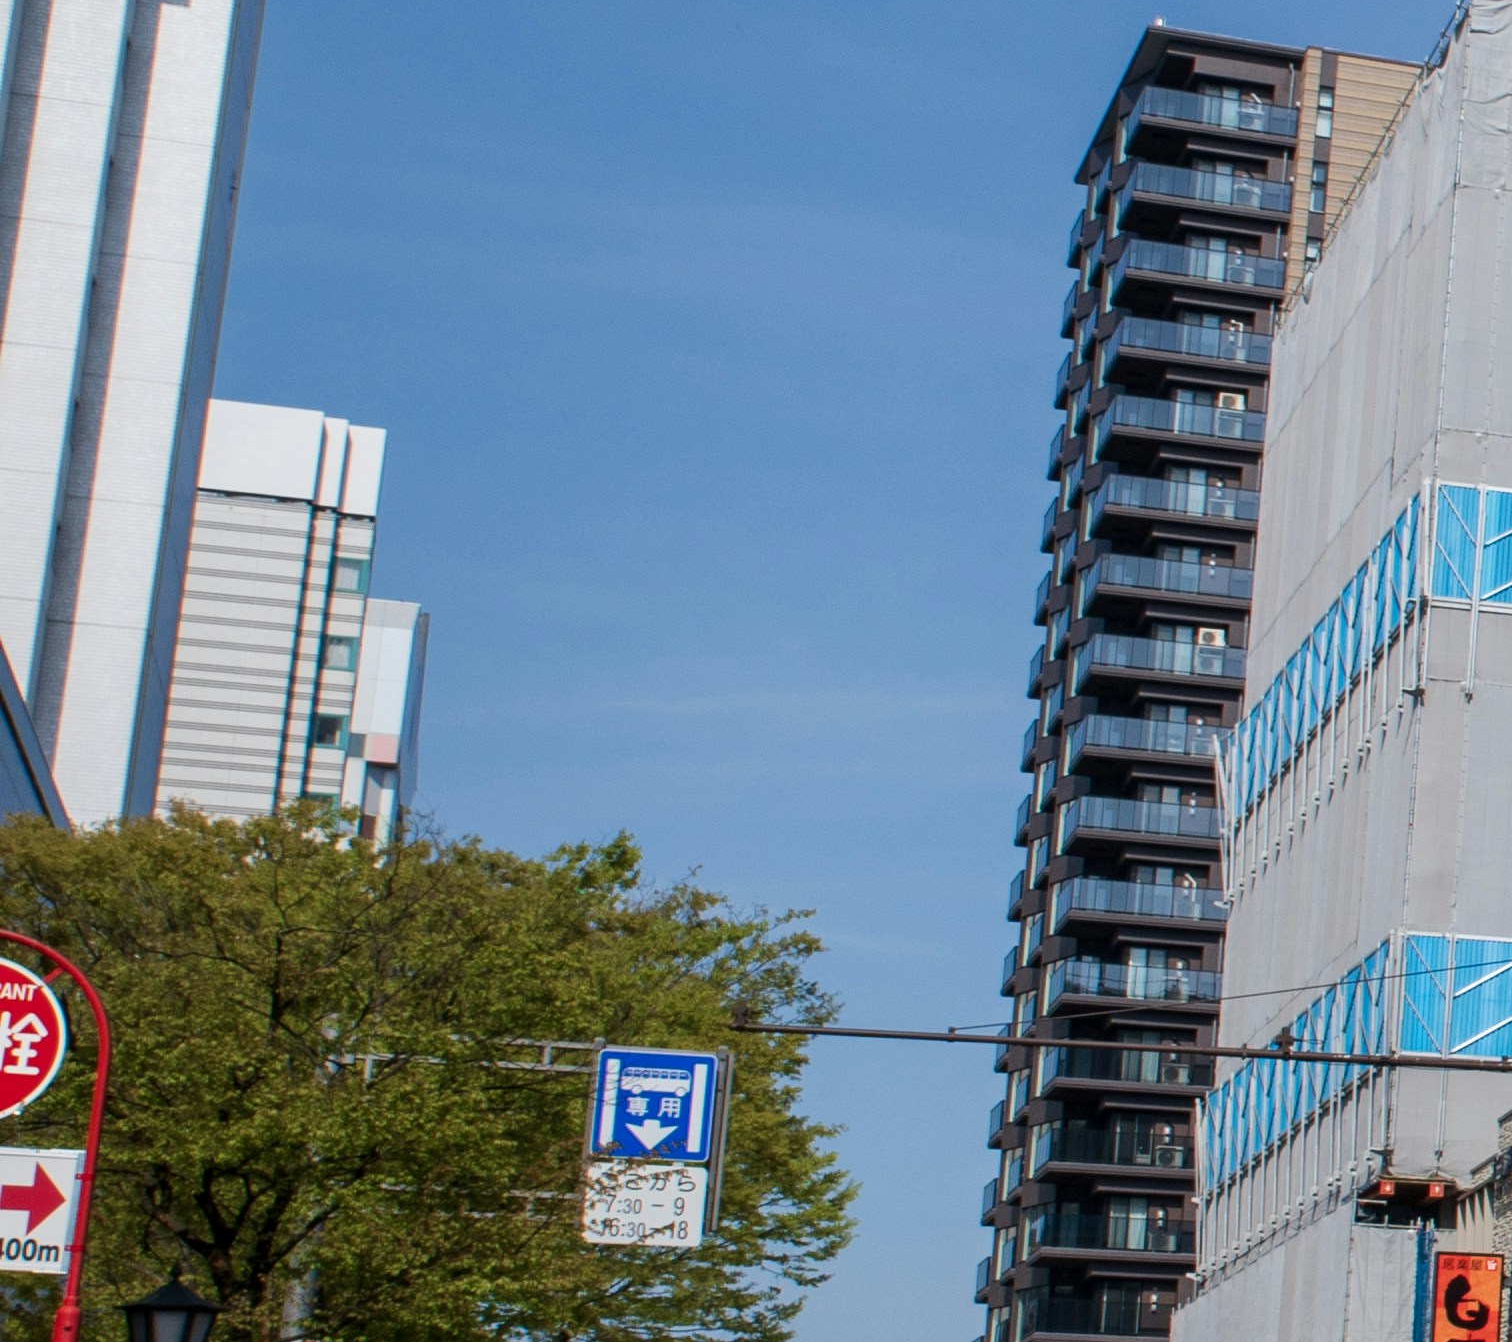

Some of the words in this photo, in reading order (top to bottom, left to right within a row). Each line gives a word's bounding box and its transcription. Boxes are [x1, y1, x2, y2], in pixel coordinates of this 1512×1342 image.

[626, 1096, 681, 1119] 専用
[674, 1197, 686, 1217] 9
[0, 1237, 60, 1262] 00m
